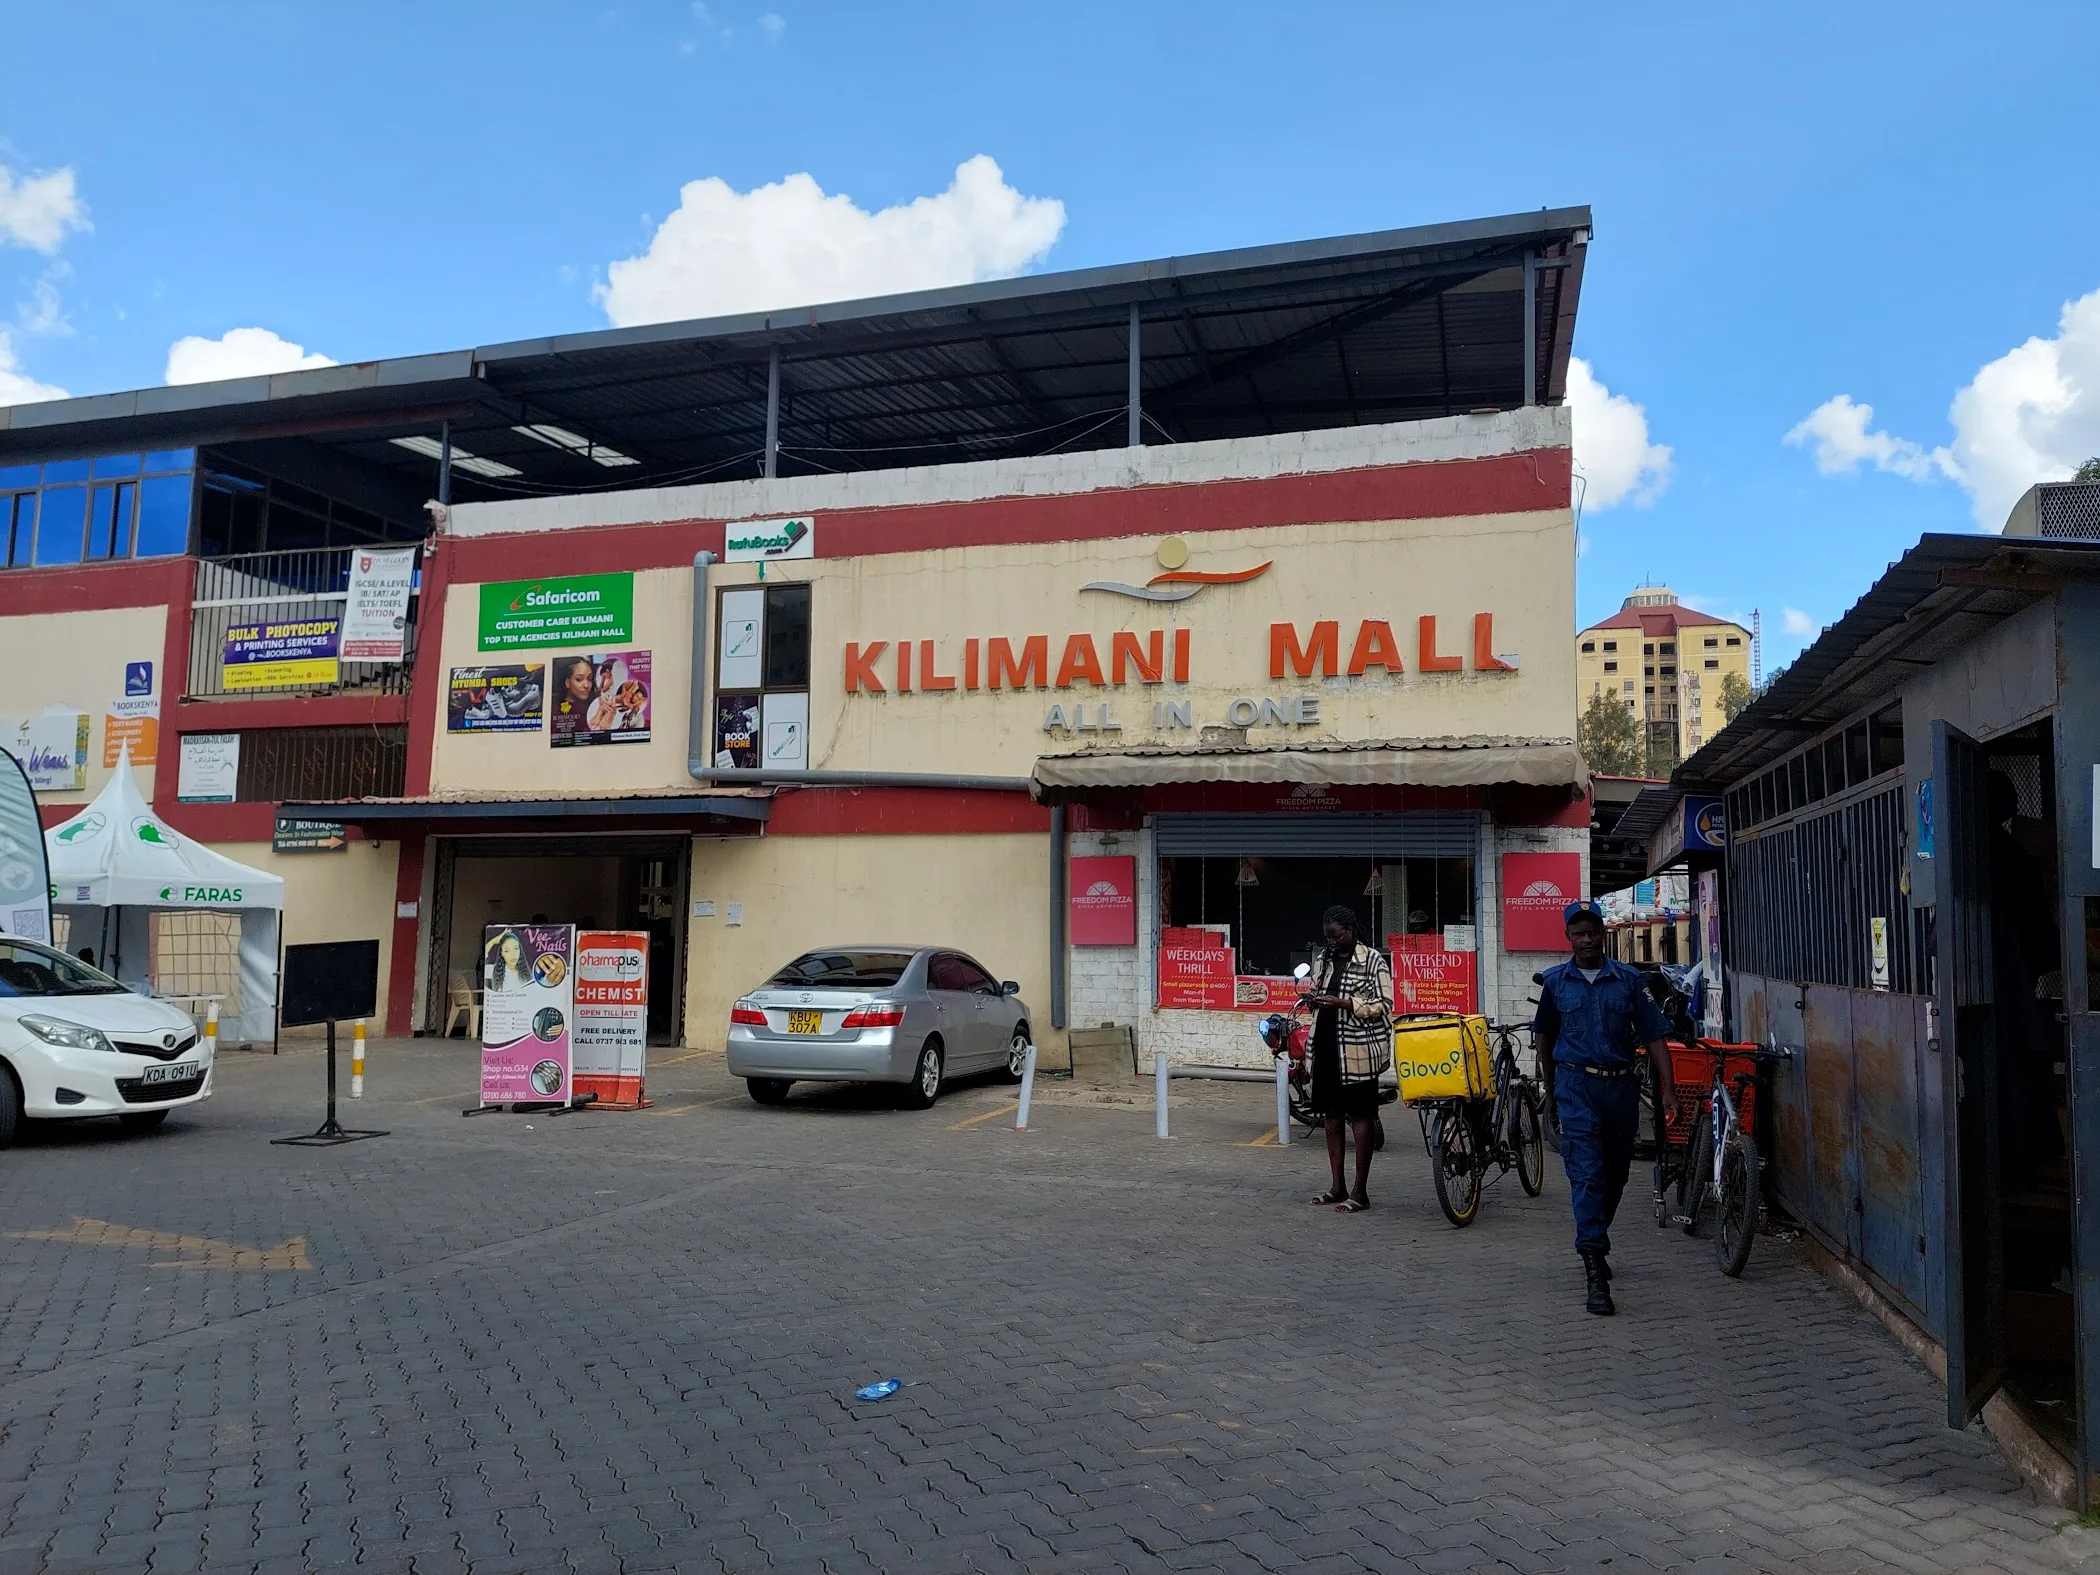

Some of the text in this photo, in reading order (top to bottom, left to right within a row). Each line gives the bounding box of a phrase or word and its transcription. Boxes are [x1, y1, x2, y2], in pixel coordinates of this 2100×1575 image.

[728, 534, 790, 550] RafuBooks
[386, 580, 410, 588] LEVEL
[526, 588, 600, 606] Safaricom
[380, 600, 402, 608] TOEFL
[361, 609, 396, 617] TUITION
[496, 614, 614, 630] CUSTOMER CARE KILIMANI
[228, 620, 338, 642] BULK PHOTOCOPY
[484, 628, 626, 644] TOP TEN AGENCIES KILIMANI MALL
[234, 636, 328, 652] & PRINTING SERVICES
[844, 612, 1520, 692] KILIMANI MALL
[454, 666, 492, 680] Finest
[490, 676, 518, 686] SHOES
[1043, 695, 1320, 731] ALL IN ONE
[724, 732, 750, 740] BOOK
[724, 740, 750, 748] STORE
[1276, 798, 1316, 806] FREEDOM
[184, 887, 243, 902] FARAS
[524, 928, 552, 944] Vee
[536, 937, 568, 952] Nails
[580, 952, 638, 968] pharmapus
[1166, 950, 1225, 962] WEEKDAYS
[1400, 954, 1462, 970] WEEKEND
[1177, 962, 1214, 974] THRILL
[1415, 968, 1444, 979] VIBES
[576, 988, 645, 1000] CHEMIST
[790, 1012, 812, 1022] KBU
[788, 1023, 817, 1034] 307A
[484, 1056, 514, 1064] Visit Us:
[146, 1064, 197, 1082] KDA 091U
[482, 1064, 528, 1073] Shop no.G34
[1400, 1060, 1452, 1078] Glovo
[483, 1081, 500, 1089] Call
